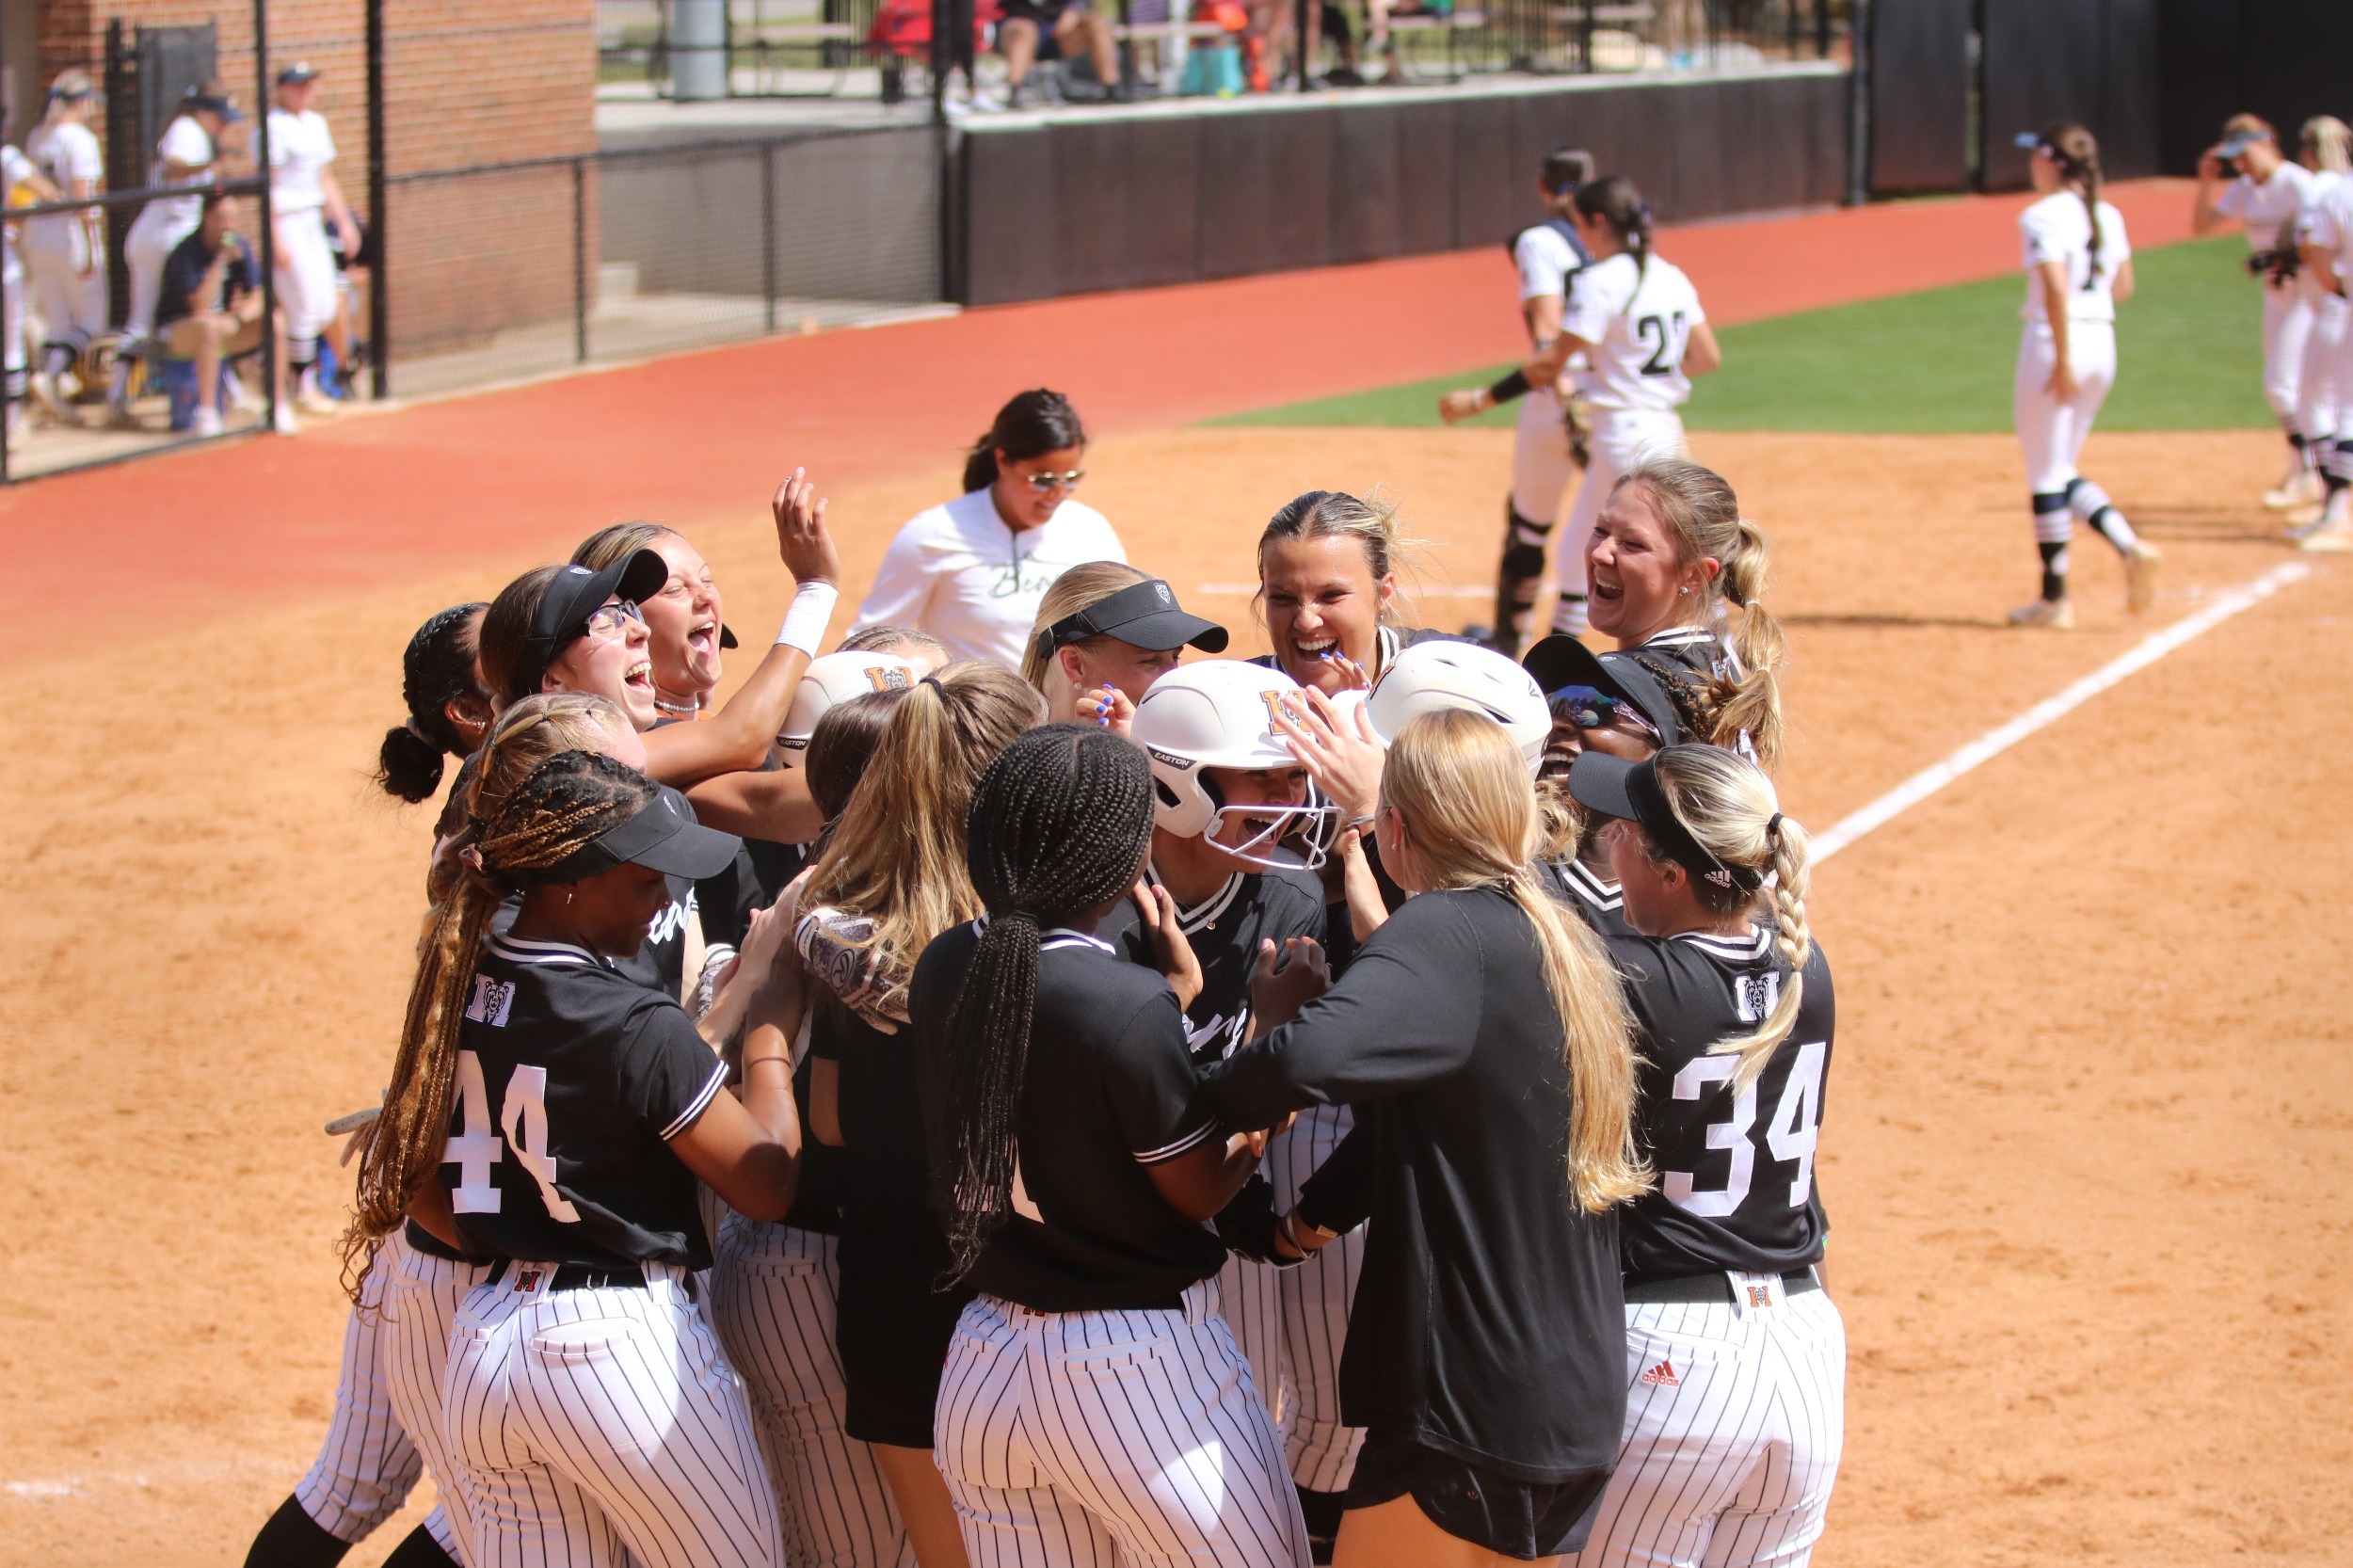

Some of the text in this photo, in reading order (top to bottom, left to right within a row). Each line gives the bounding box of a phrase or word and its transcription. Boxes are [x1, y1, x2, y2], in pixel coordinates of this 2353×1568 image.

[1638, 311, 1685, 376] 2
[1154, 752, 1191, 767] EASTON
[1705, 872, 1731, 888] adidas
[440, 1048, 582, 1224] 44
[1663, 1041, 1827, 1218] 34
[1641, 1372, 1680, 1387] adidas
